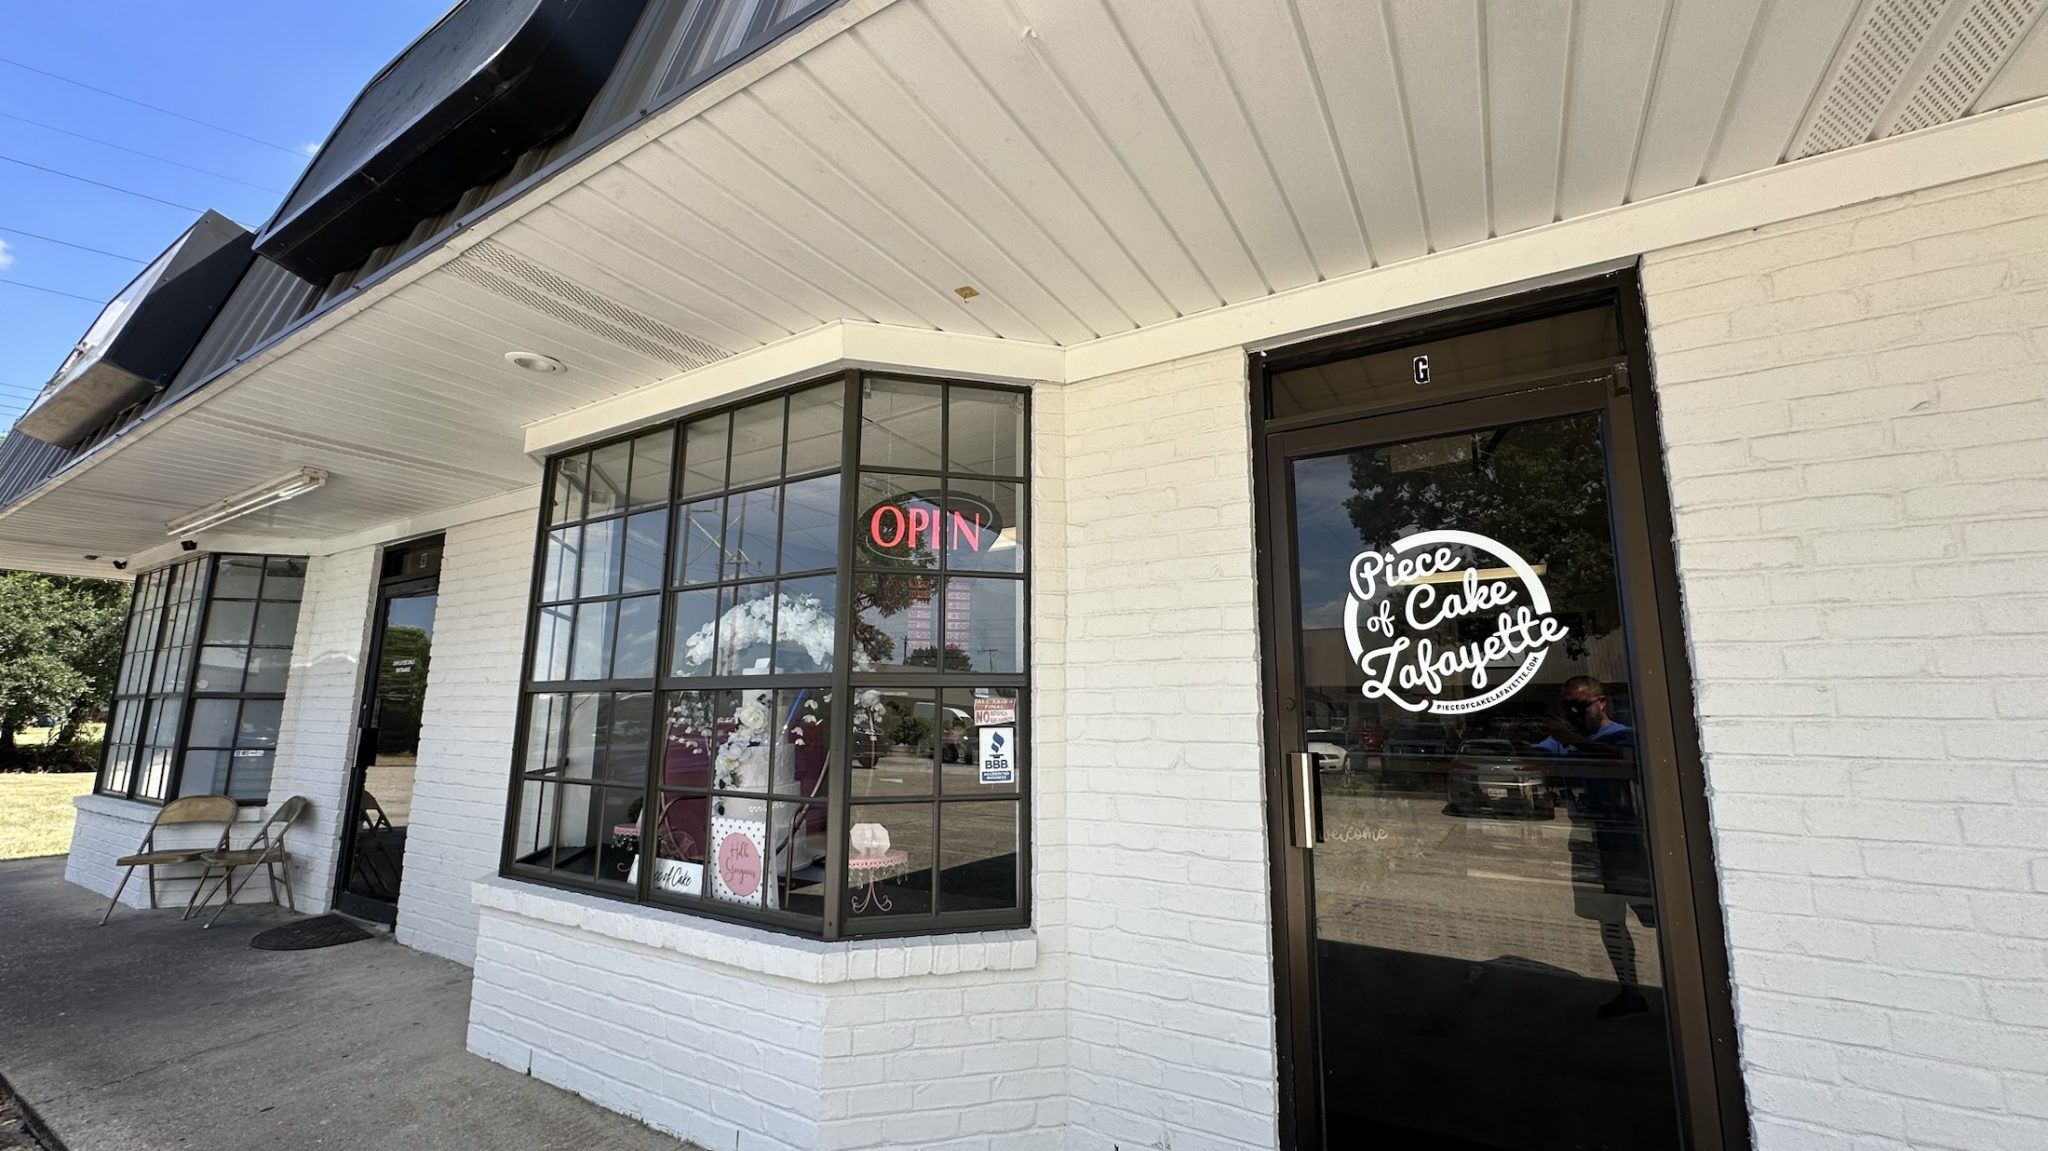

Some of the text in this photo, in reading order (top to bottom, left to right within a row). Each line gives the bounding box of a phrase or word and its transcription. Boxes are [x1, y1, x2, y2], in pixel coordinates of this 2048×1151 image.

[1414, 357, 1430, 383] G
[870, 504, 980, 551] OPEN
[1349, 547, 1461, 600] Piece
[1367, 567, 1518, 637] of Cake
[1361, 606, 1570, 712] Lafayette
[1436, 656, 1540, 711] PIECEOFCAKELAFAYETTE.COM
[976, 711, 990, 724] NO
[985, 760, 1008, 769] BBB
[671, 867, 692, 887] Cake
